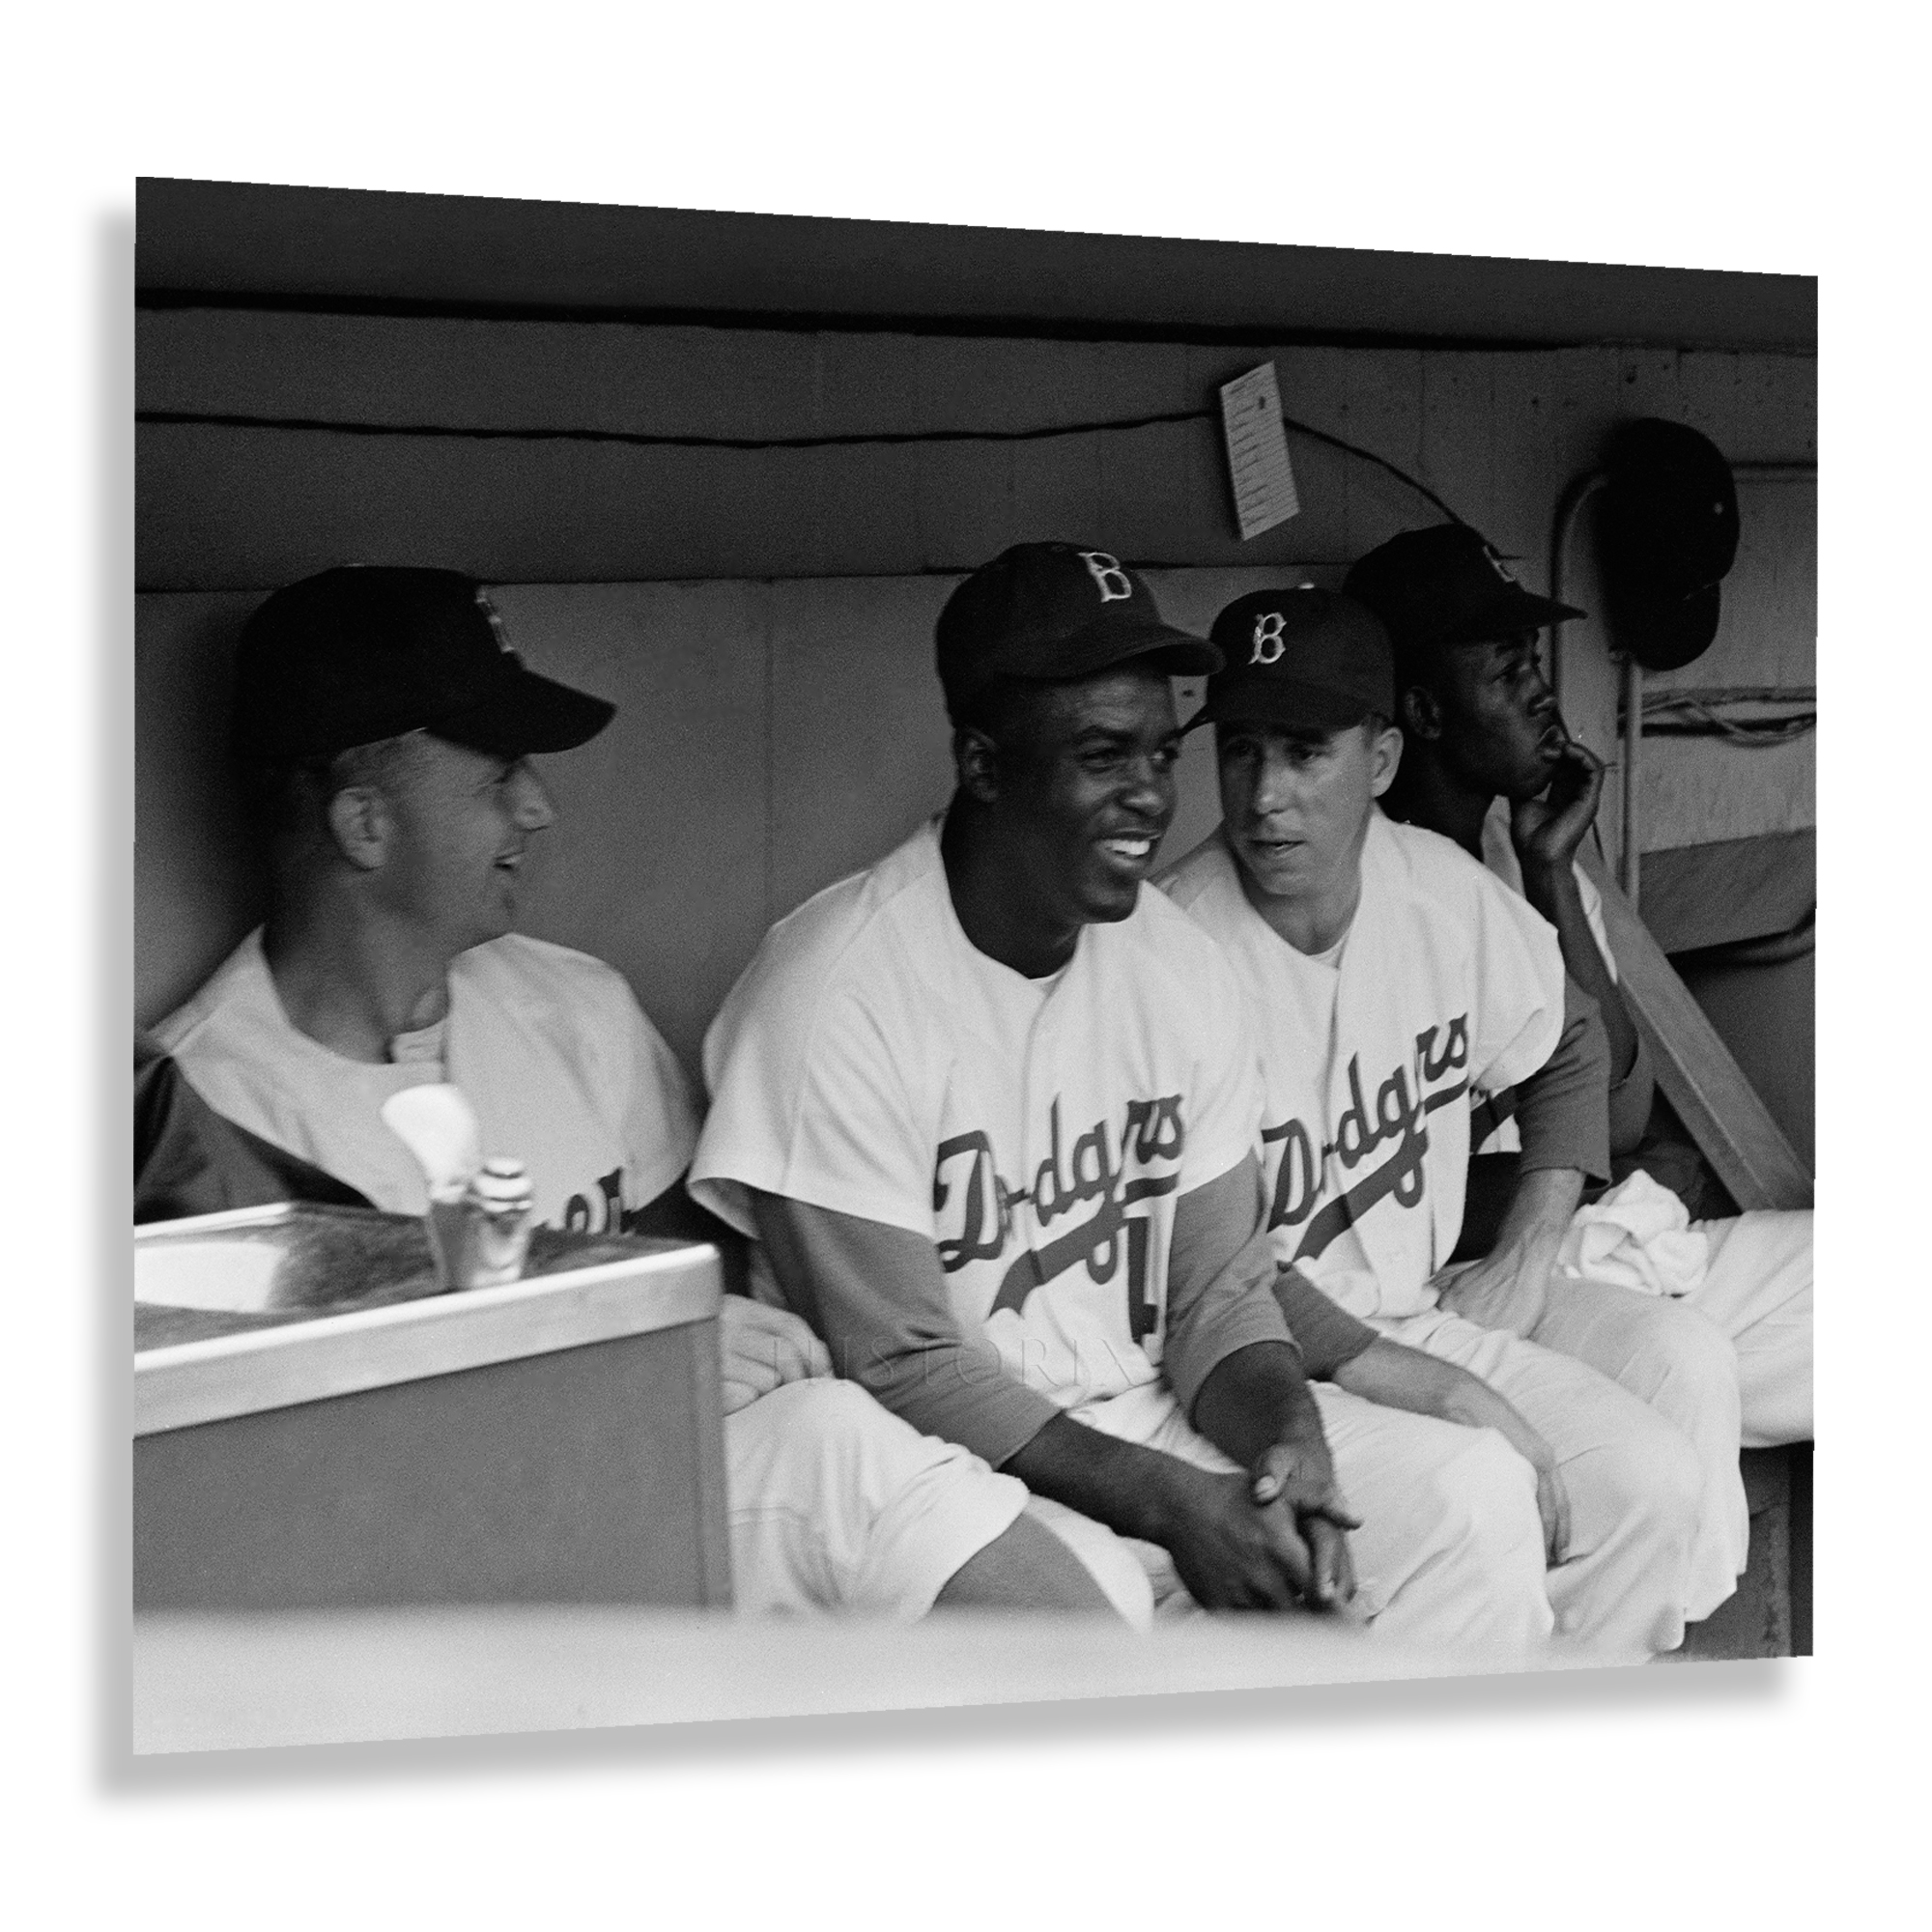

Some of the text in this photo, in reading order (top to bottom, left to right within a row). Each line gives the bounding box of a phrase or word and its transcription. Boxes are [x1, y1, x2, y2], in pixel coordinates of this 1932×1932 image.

[1077, 552, 1132, 603] B
[1248, 611, 1288, 665] B
[1260, 1010, 1468, 1236] Ddgrs
[933, 1092, 1184, 1287] Ddgrs
